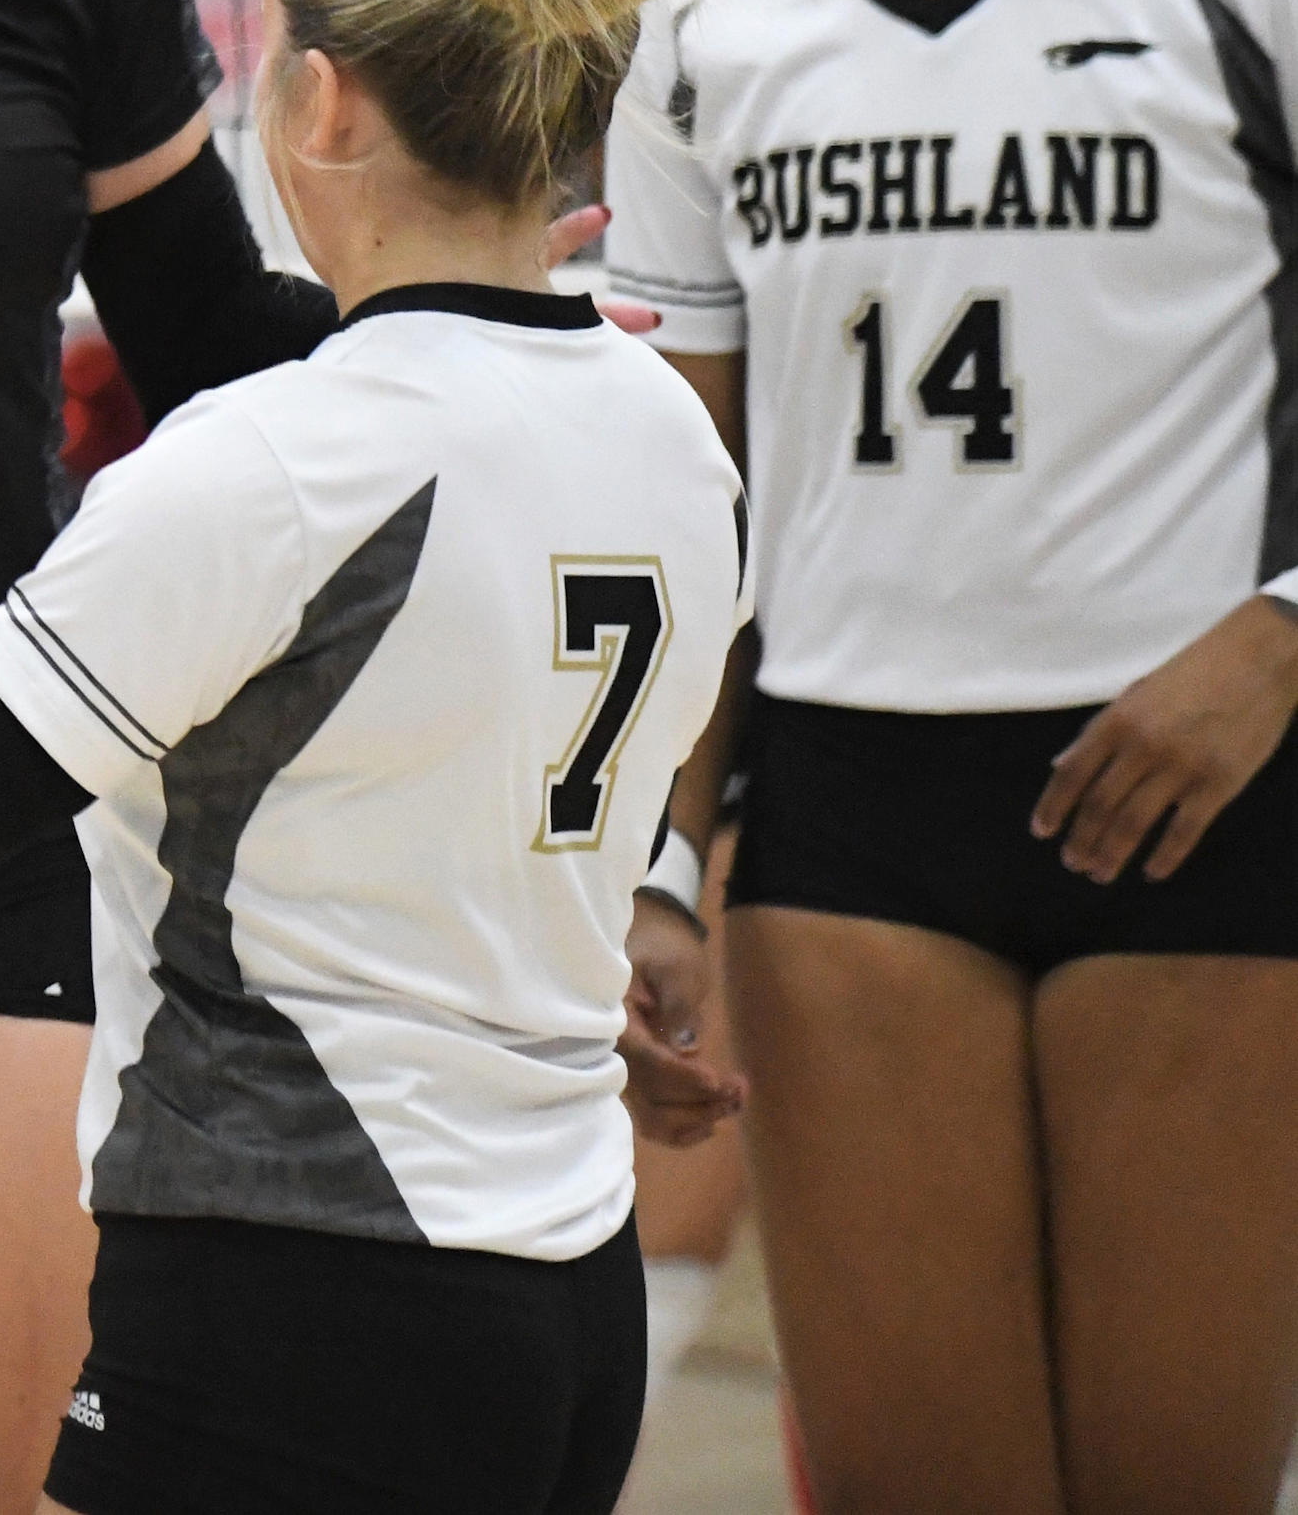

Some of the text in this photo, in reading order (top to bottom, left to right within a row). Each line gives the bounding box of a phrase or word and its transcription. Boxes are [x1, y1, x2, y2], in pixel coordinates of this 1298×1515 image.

[732, 130, 1161, 247] BUSHLAND
[844, 288, 1022, 475] 14
[530, 553, 674, 852] 7
